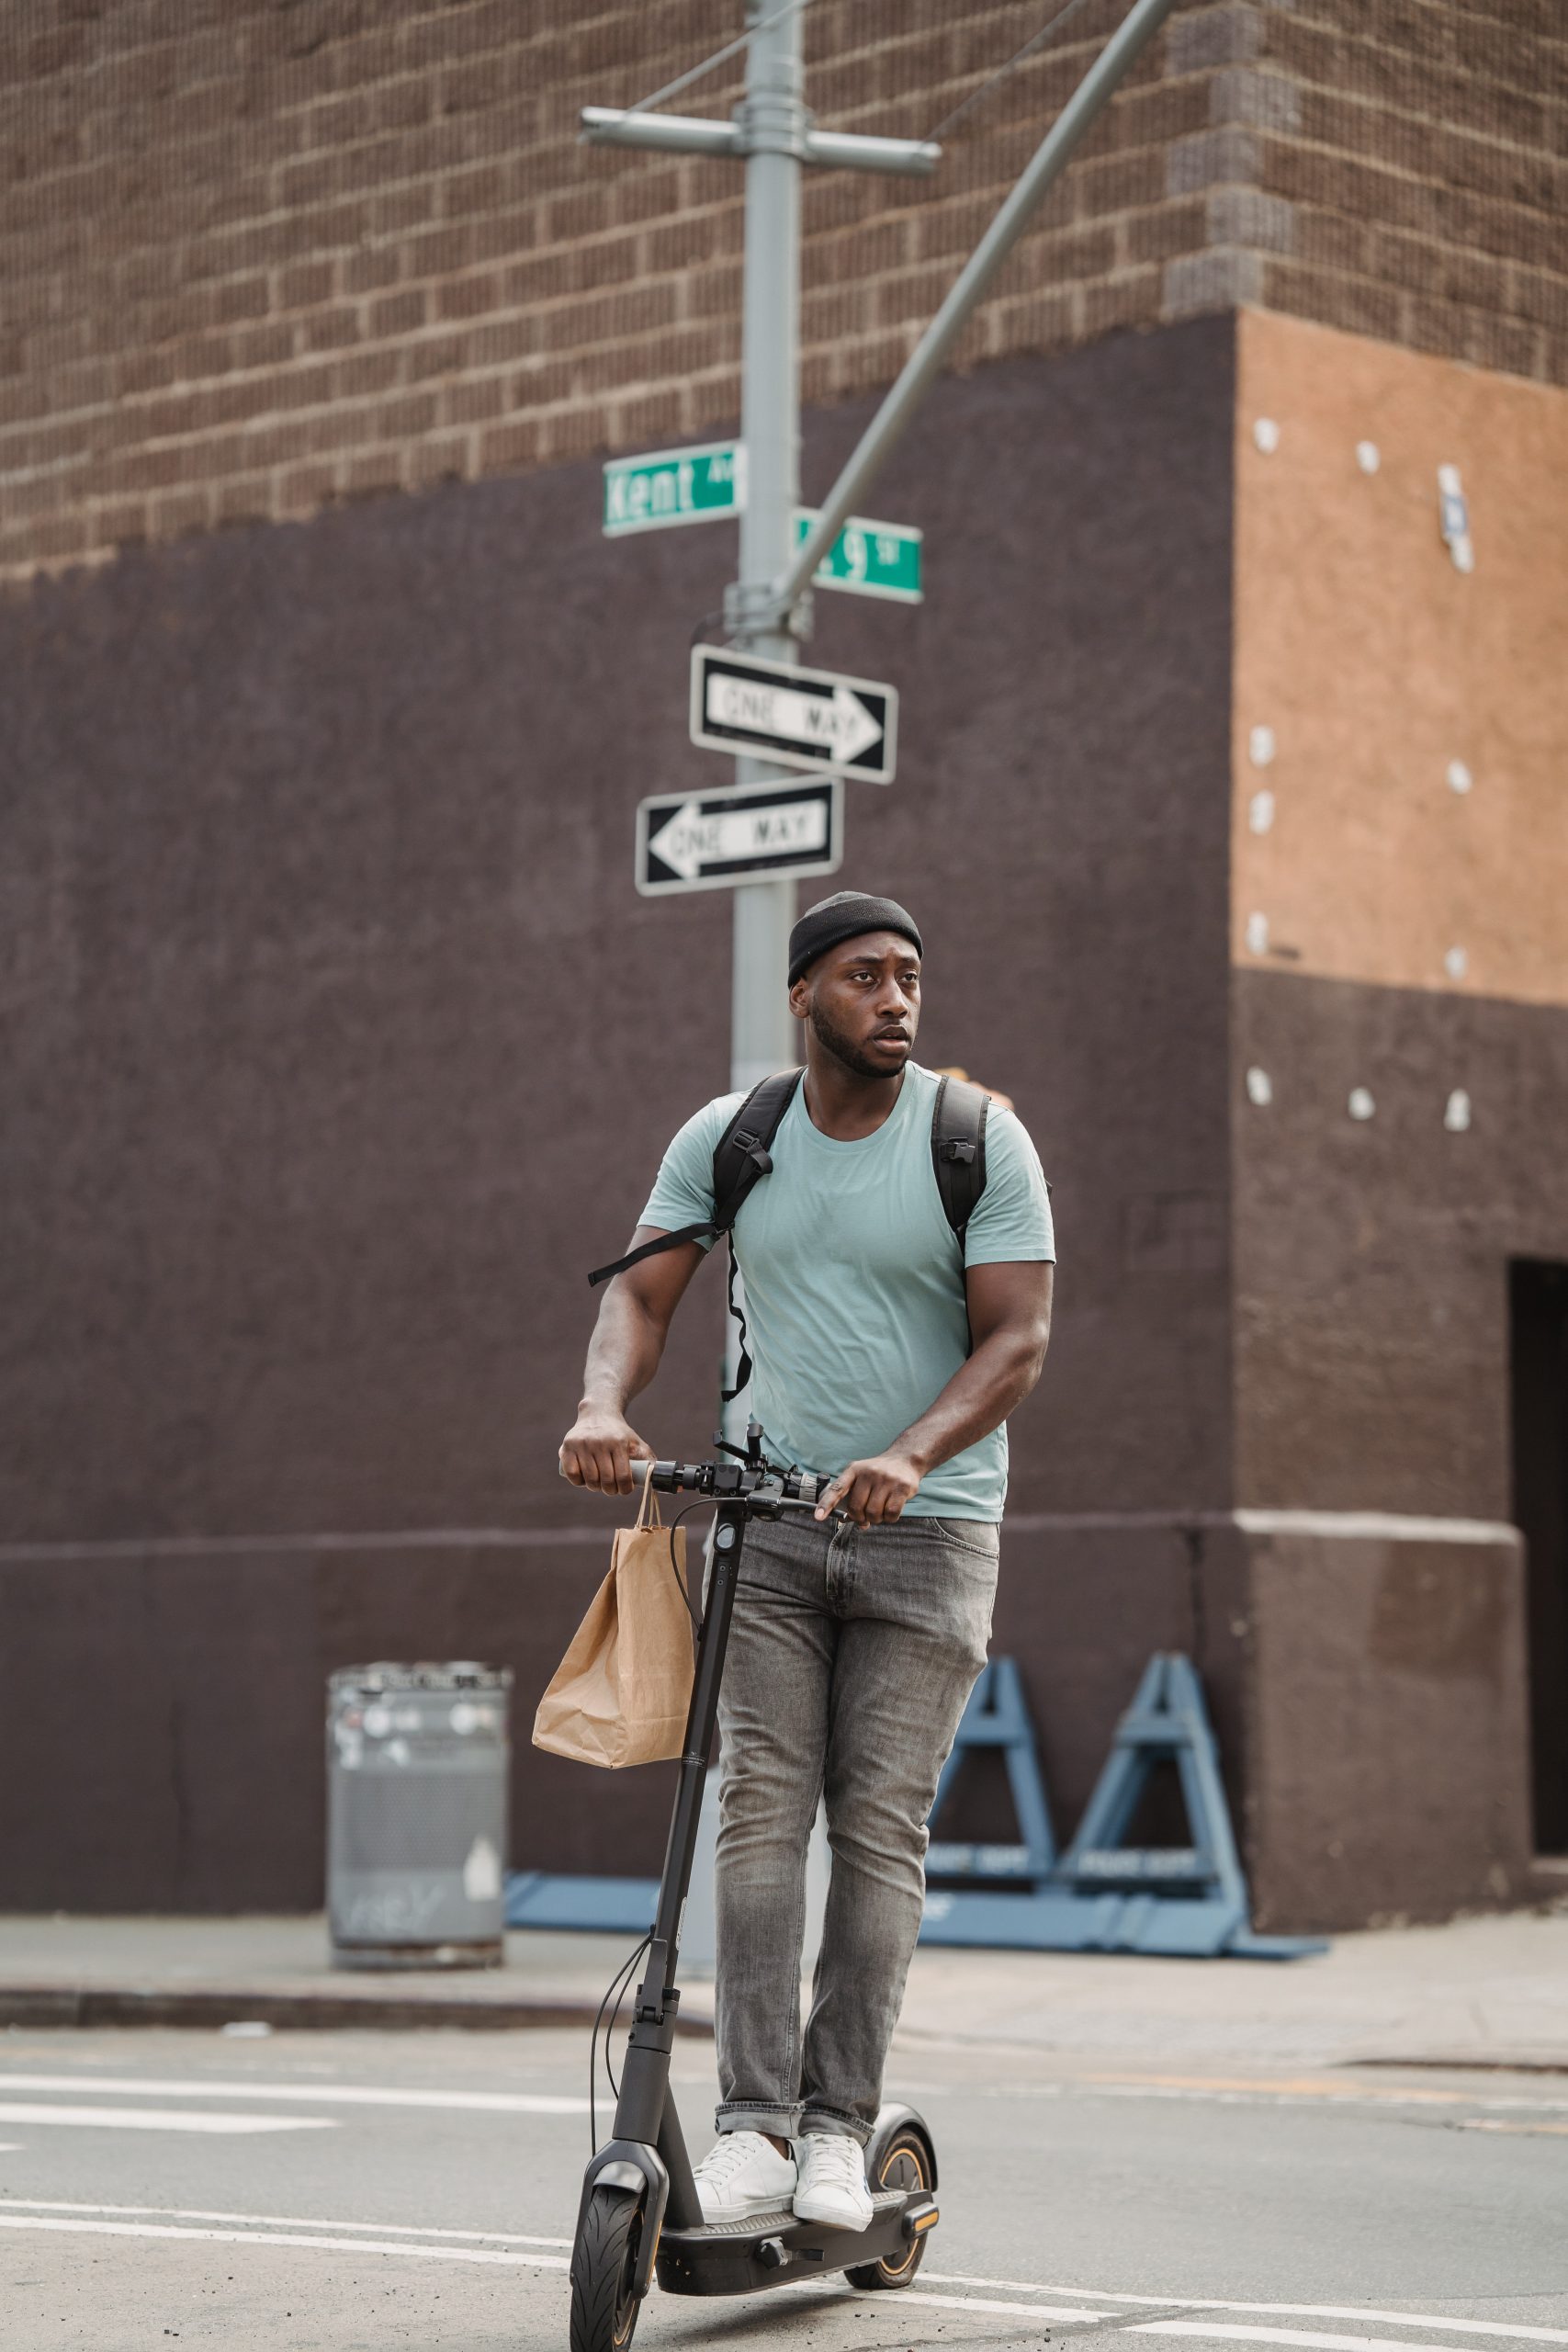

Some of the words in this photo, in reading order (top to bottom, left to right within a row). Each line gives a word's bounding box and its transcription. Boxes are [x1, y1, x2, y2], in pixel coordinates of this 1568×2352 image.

[607, 459, 694, 522] Kent
[843, 528, 868, 582] 9
[724, 685, 773, 724] ONE
[805, 704, 859, 738] WAY
[670, 822, 720, 856] ONE
[752, 814, 807, 844] WAY
